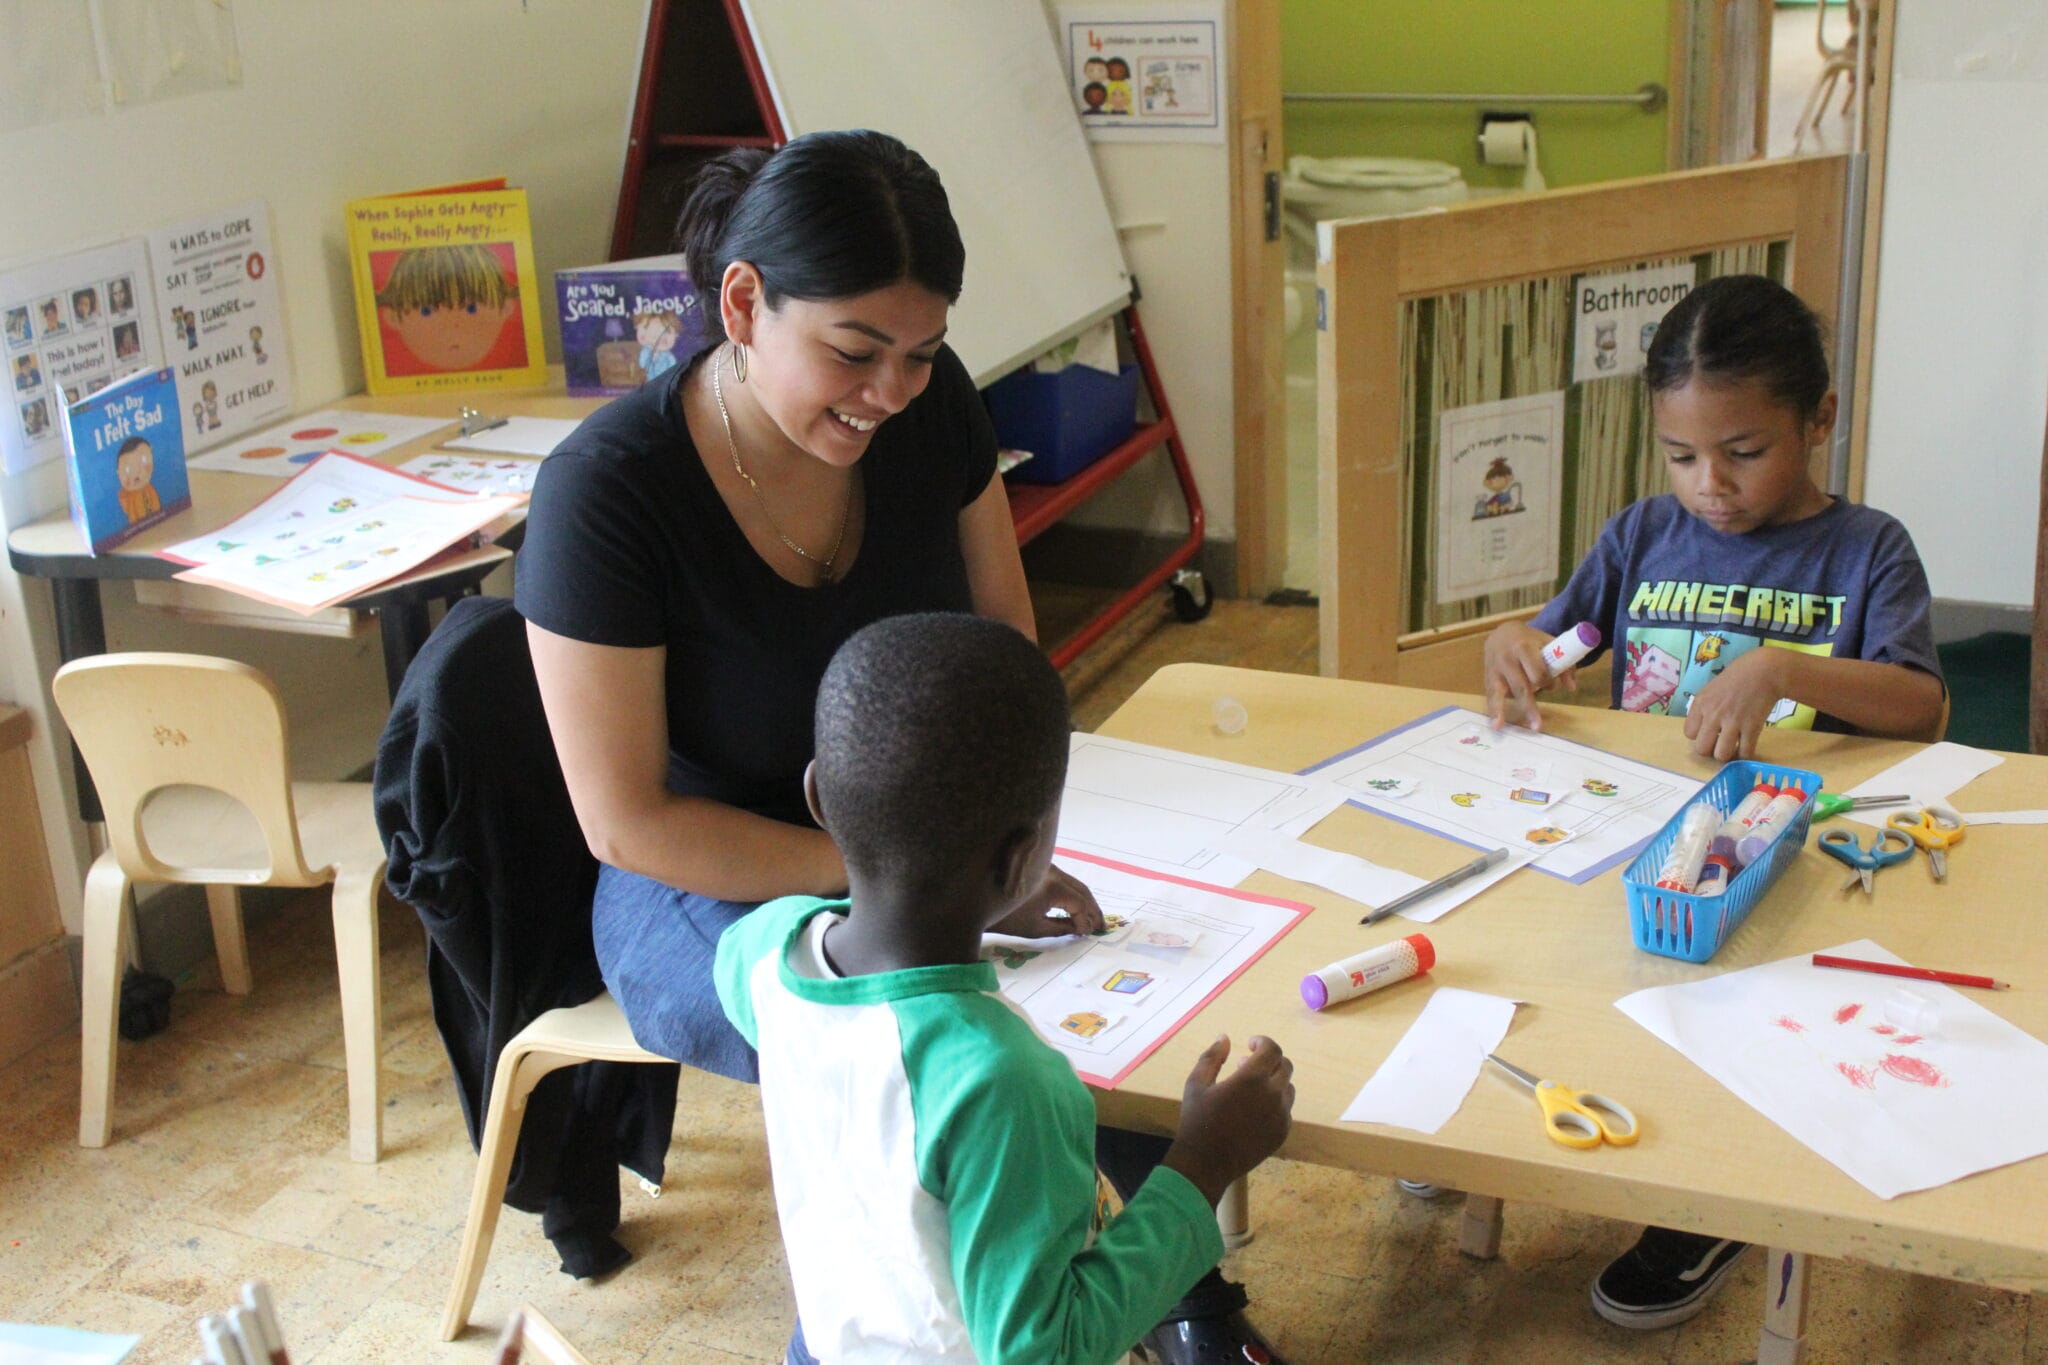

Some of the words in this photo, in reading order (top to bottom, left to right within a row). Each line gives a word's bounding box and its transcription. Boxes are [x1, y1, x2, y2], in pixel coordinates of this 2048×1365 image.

[1088, 30, 1103, 52] 4
[355, 209, 389, 222] When
[395, 206, 434, 222] Sophie
[439, 203, 465, 216] Gets
[170, 239, 178, 253] 4
[180, 230, 208, 250] WAYS
[224, 218, 251, 238] COPE
[415, 224, 451, 240] Really
[167, 271, 187, 291] SAY
[567, 285, 587, 299] Are
[564, 297, 630, 322] Scared,
[633, 294, 695, 317] Jacob?
[1583, 283, 1689, 314] Bathroom
[201, 299, 240, 324] IGNORE
[47, 350, 65, 363] This
[77, 341, 98, 354] how
[182, 356, 212, 377] WALK
[216, 344, 243, 366] AWAY
[225, 390, 244, 409] GET
[247, 379, 274, 401] HELP
[104, 402, 124, 419] The
[125, 395, 144, 410] Day
[94, 428, 103, 451] I
[104, 416, 131, 446] Felt
[134, 403, 163, 431] Sad
[1627, 580, 1848, 637] MINECRAFT
